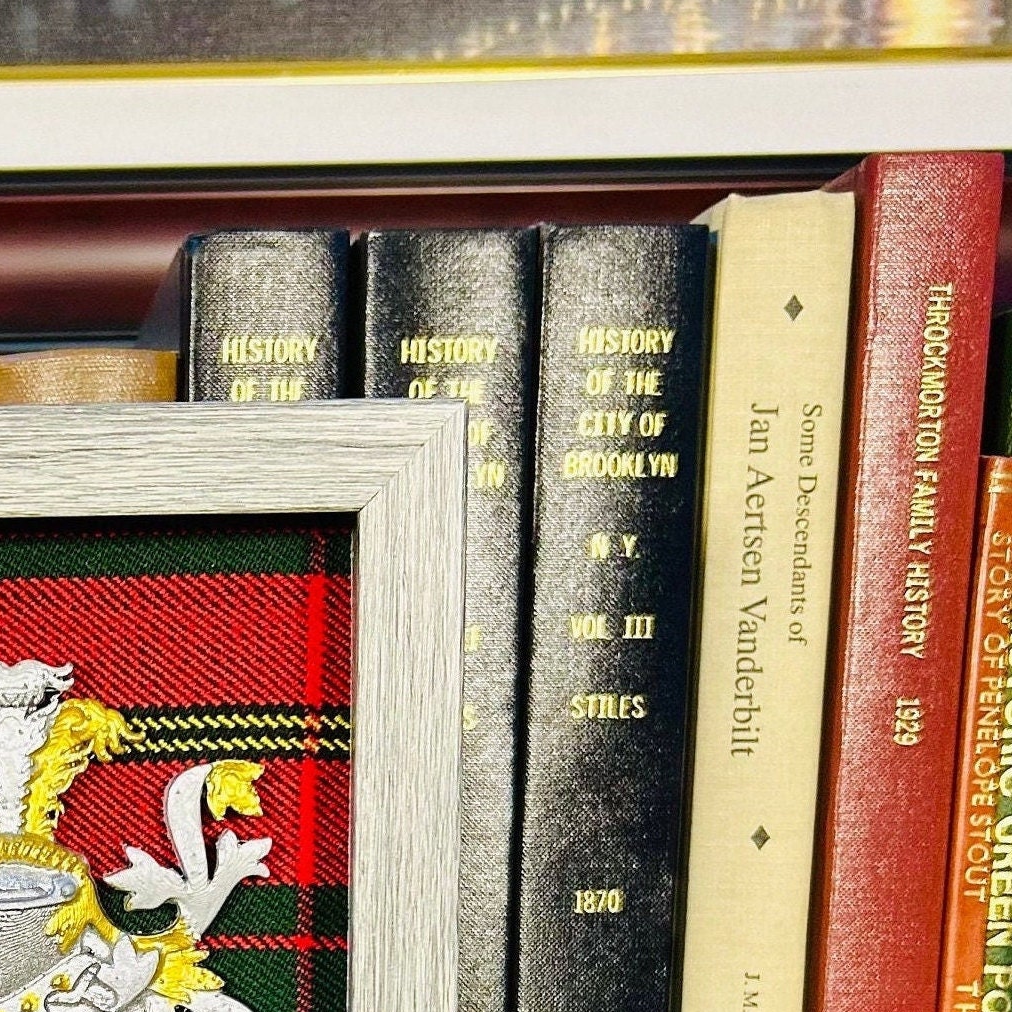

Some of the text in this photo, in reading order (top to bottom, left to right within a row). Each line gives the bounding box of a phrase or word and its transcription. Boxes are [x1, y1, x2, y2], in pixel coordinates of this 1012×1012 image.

[221, 335, 318, 364] HISTORY
[400, 335, 499, 365] HISTORY
[576, 328, 677, 356] HISTORY
[230, 376, 257, 402] OF
[408, 376, 438, 399] OF
[585, 368, 664, 397] OF THE
[578, 409, 668, 438] CITY OF
[562, 450, 680, 479] BROOKLYN
[788, 402, 823, 647] Some Descendants of
[892, 281, 953, 747] THROCKMORTON FAMILY HISTORY 1929
[730, 402, 780, 760] Jan Aertsen Vanderbilt
[985, 529, 1012, 626] STORY
[569, 612, 656, 641] VOL III
[981, 633, 1006, 669] OF
[569, 692, 648, 721] STILES
[971, 676, 1005, 808] PENELOPE
[963, 813, 996, 904] STOUT
[572, 887, 625, 915] 1870
